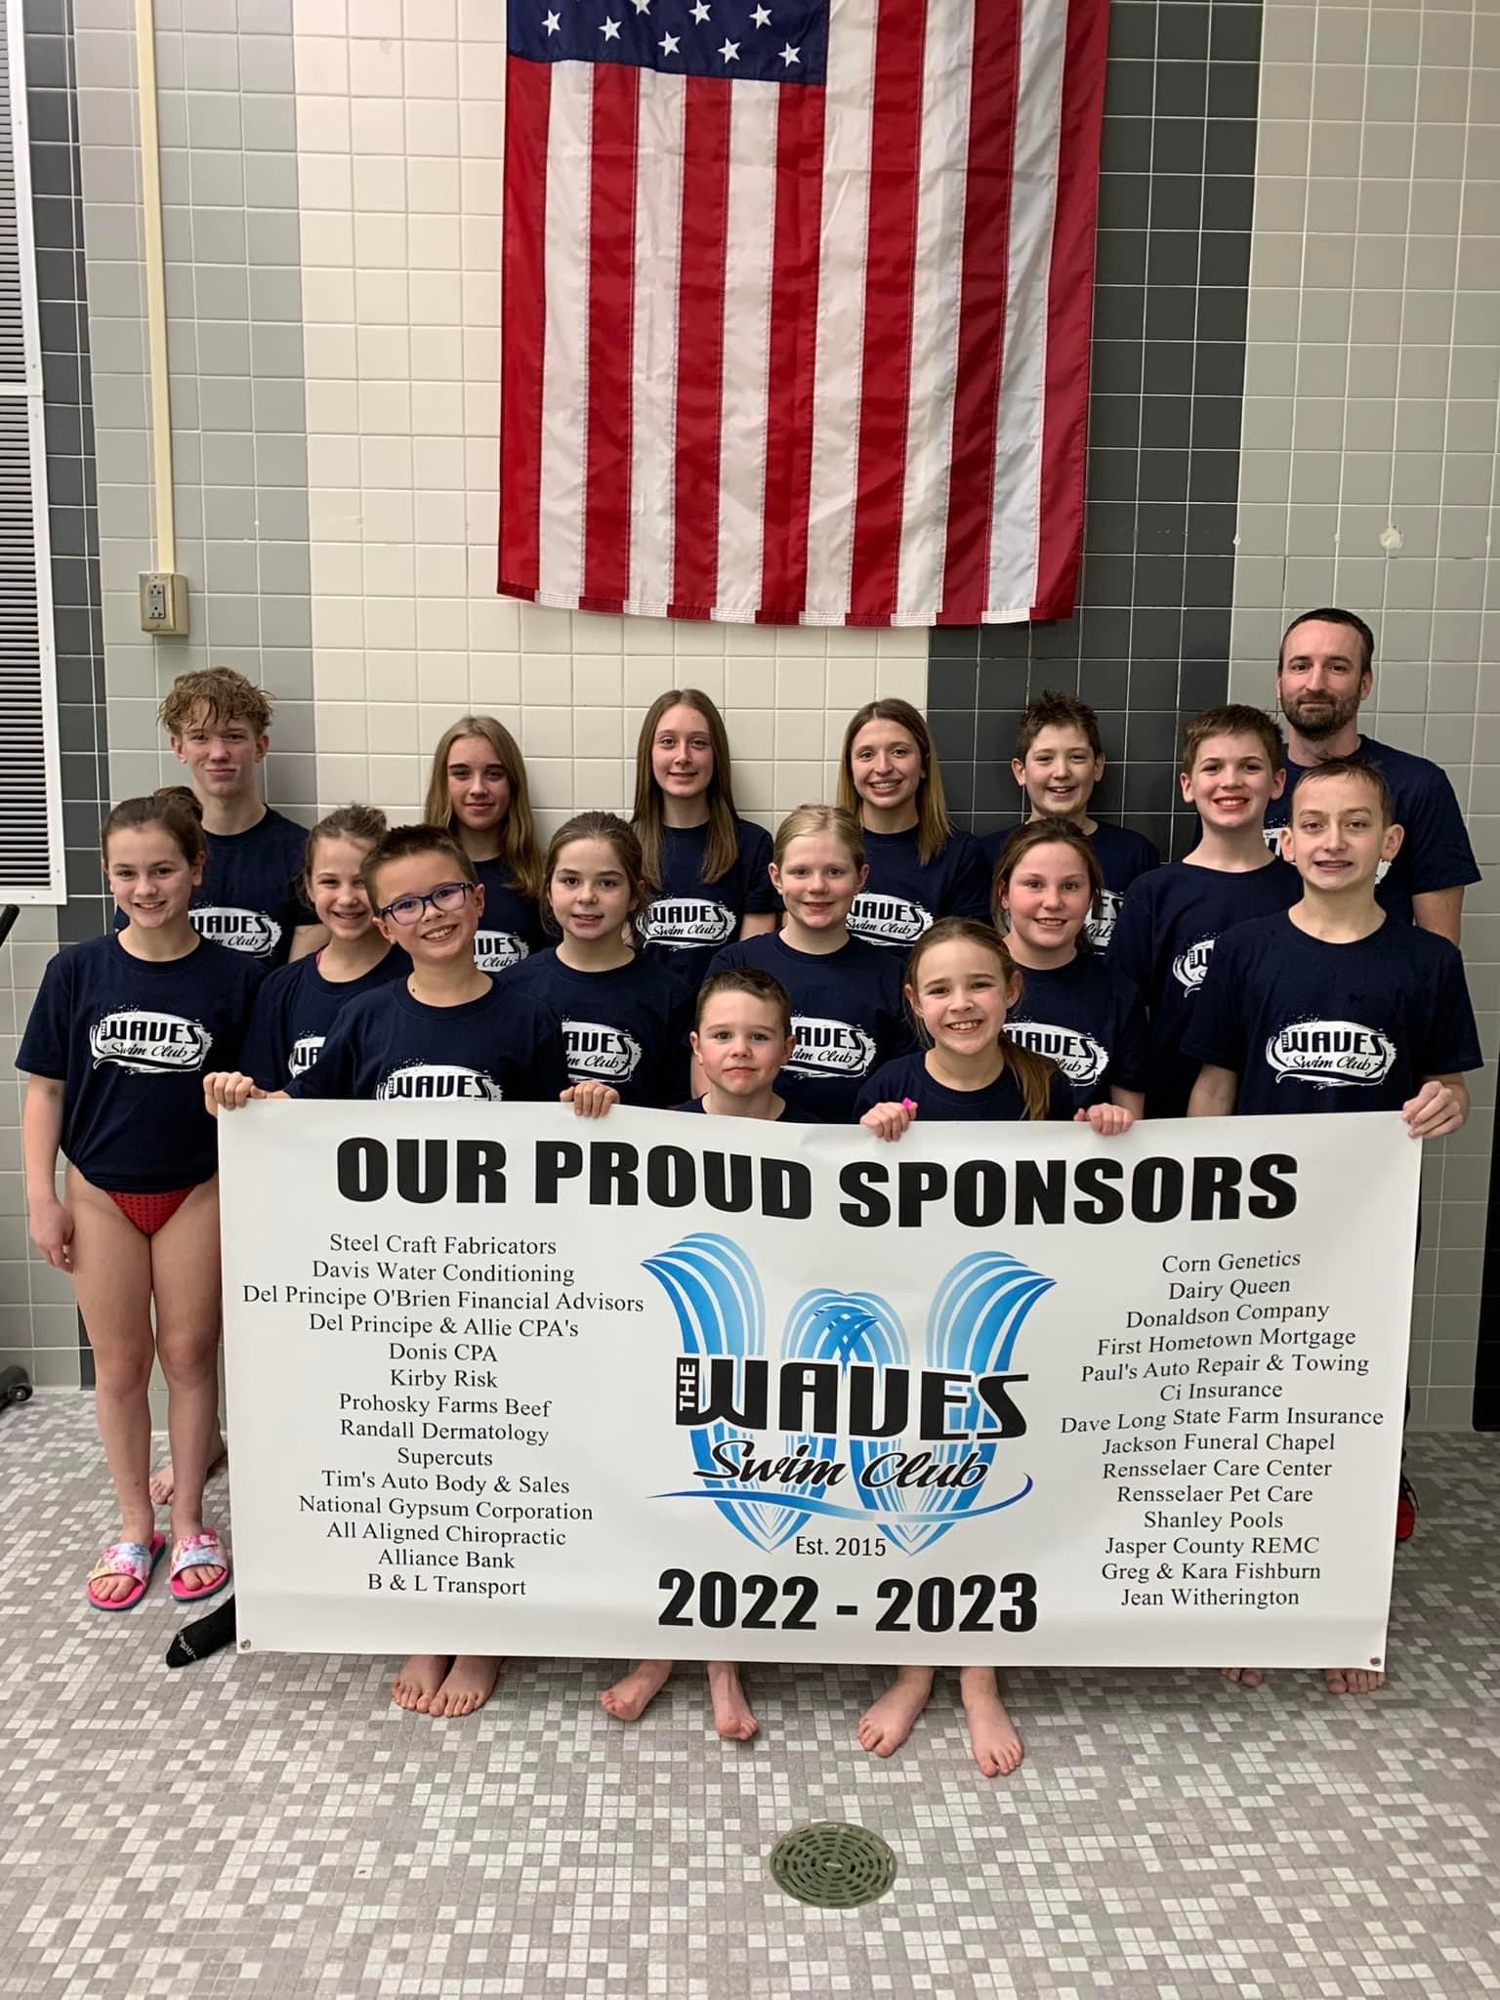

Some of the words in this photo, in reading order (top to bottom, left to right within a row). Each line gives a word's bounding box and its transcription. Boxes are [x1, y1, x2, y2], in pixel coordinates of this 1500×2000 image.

[227, 935, 259, 946] Club
[650, 925, 684, 936] Swim
[687, 924, 716, 936] Club
[881, 923, 911, 935] Club
[474, 937, 518, 955] VES
[482, 957, 512, 968] Club
[101, 1020, 200, 1045] WAVES
[564, 1031, 630, 1055] AVES
[795, 1026, 862, 1050] AVES
[1281, 1031, 1385, 1056] WAVES
[109, 1042, 147, 1056] Swim
[151, 1045, 187, 1058] Club
[584, 1056, 619, 1068] Club
[818, 1050, 852, 1063] Club
[1057, 1058, 1081, 1072] lub
[1291, 1055, 1333, 1069] Swim
[1336, 1056, 1371, 1070] Club
[388, 1075, 489, 1099] WAVES
[336, 1136, 507, 1205] OUR
[534, 1140, 812, 1220] PROUD
[838, 1153, 1298, 1228] SPONSORS
[330, 1233, 379, 1252] Steel
[386, 1234, 437, 1254] Craft
[445, 1236, 557, 1255] Fabricators
[313, 1260, 370, 1279] Davis
[376, 1261, 437, 1281] Water
[442, 1263, 575, 1287] Conditioning
[1162, 1255, 1211, 1274] Corn
[1218, 1249, 1301, 1271] Genetics
[243, 1284, 277, 1303] Del
[286, 1285, 367, 1310] Principe
[373, 1288, 450, 1307] O'Brien
[458, 1290, 549, 1310] Financial
[555, 1291, 644, 1312] Advisors
[1169, 1280, 1224, 1302] Dairy
[1229, 1278, 1290, 1299] Queen
[310, 1313, 343, 1331] Del
[351, 1314, 433, 1338] Principe
[439, 1317, 458, 1334] &
[463, 1318, 512, 1337] Allie
[518, 1319, 579, 1337] CPA's
[1126, 1307, 1229, 1329] Donaldson
[1236, 1303, 1330, 1323] Company
[390, 1342, 448, 1360] Donis
[454, 1343, 498, 1362] CPA
[1097, 1338, 1141, 1356] First
[1149, 1333, 1252, 1353] Hometown
[1259, 1327, 1356, 1350] Mortgage
[391, 1368, 447, 1392] Kirby
[455, 1369, 498, 1388] Risk
[1081, 1363, 1138, 1383] Paul's
[1142, 1362, 1190, 1379] Auto
[1196, 1354, 1261, 1377] Repair
[1266, 1353, 1284, 1371] &
[1291, 1353, 1369, 1377] Towing
[676, 1357, 1029, 1441] WAVES
[678, 1363, 696, 1412] THE
[1159, 1383, 1182, 1402] Ci
[1189, 1383, 1283, 1400] Insurance
[340, 1392, 430, 1418] Prohosky
[438, 1396, 498, 1414] Farms
[505, 1398, 553, 1418] Beef
[1061, 1417, 1111, 1434] Dave
[1117, 1413, 1167, 1431] Long
[1173, 1408, 1221, 1425] State
[1227, 1406, 1279, 1424] Farm
[1286, 1407, 1384, 1426] Insurance
[341, 1418, 414, 1439] Randall
[422, 1422, 549, 1447] Dermatology
[1101, 1436, 1176, 1455] Jackson
[1184, 1432, 1258, 1450] Funeral
[1265, 1432, 1335, 1455] Chapel
[397, 1447, 493, 1470] Supercuts
[693, 1440, 847, 1486] Swim
[861, 1451, 988, 1489] Club
[1103, 1458, 1208, 1479] Rensselaer
[1213, 1459, 1260, 1477] Care
[1266, 1459, 1333, 1477] Center
[321, 1469, 376, 1488] Tim's
[381, 1472, 429, 1490] Auto
[436, 1474, 487, 1497] Body
[493, 1475, 511, 1493] &
[519, 1475, 570, 1494] Sales
[1117, 1484, 1224, 1503] Rensselaer
[1229, 1485, 1260, 1503] Pet
[1267, 1485, 1313, 1503] Care
[299, 1495, 381, 1514] National
[388, 1497, 469, 1520] Gypsum
[476, 1501, 593, 1524] Corporation
[1144, 1510, 1223, 1533] Shanley
[1230, 1511, 1283, 1528] Pools
[327, 1521, 356, 1539] All
[362, 1522, 439, 1545] Aligned
[445, 1525, 566, 1548] Chiropractic
[796, 1535, 829, 1556] Est.
[835, 1537, 886, 1557] 2015
[378, 1548, 459, 1567] Alliance
[466, 1551, 515, 1569] Bank
[1105, 1537, 1167, 1559] Jasper
[1173, 1537, 1245, 1559] County
[1252, 1536, 1320, 1554] REMC
[1101, 1563, 1150, 1584] Greg
[1156, 1562, 1174, 1580] &
[1182, 1562, 1228, 1579] Kara
[1235, 1562, 1321, 1579] Fishburn
[368, 1573, 382, 1590] B
[389, 1574, 407, 1591] &
[415, 1574, 428, 1592] L
[433, 1575, 526, 1599] Transport
[658, 1568, 819, 1631] 2022
[835, 1604, 859, 1616] -
[874, 1572, 1038, 1633] 2023
[1121, 1588, 1163, 1606] Jean
[1171, 1587, 1299, 1610] Witherington
